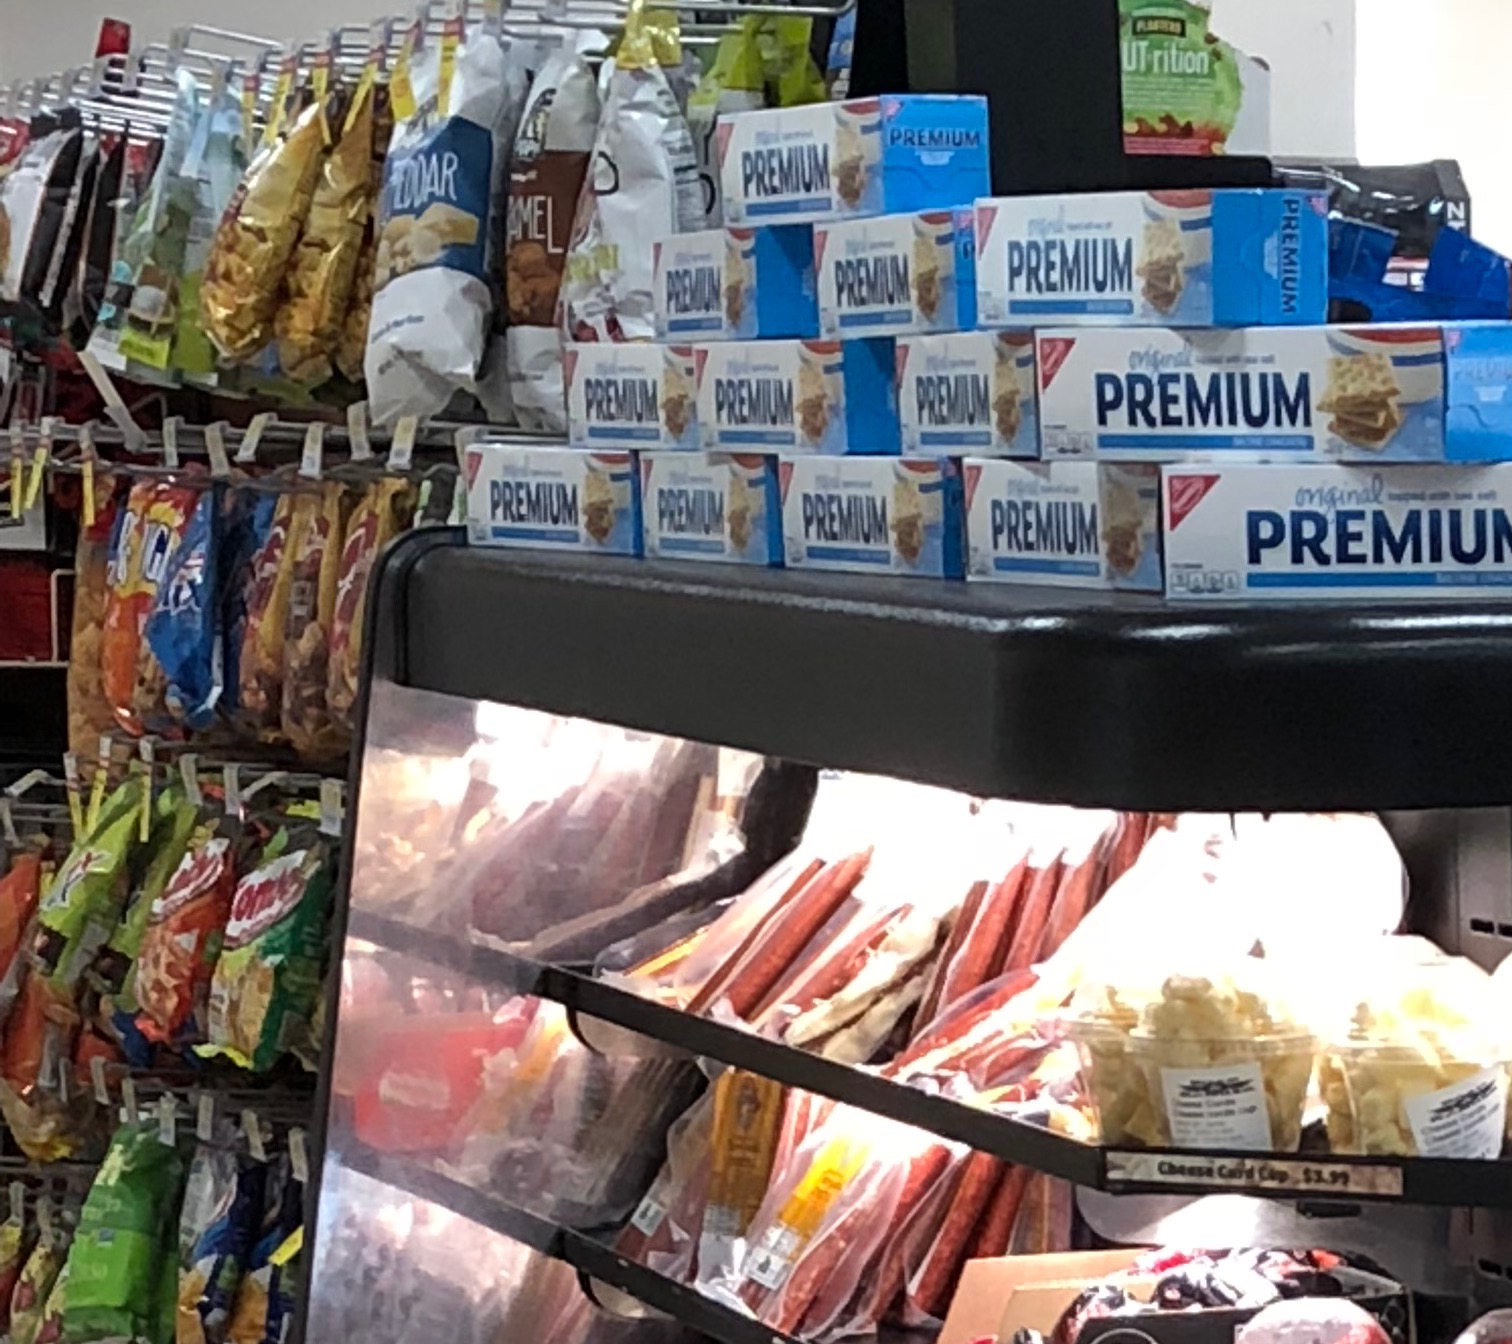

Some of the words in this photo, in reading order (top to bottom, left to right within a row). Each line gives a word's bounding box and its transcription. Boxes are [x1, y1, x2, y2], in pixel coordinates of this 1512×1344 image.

[890, 128, 980, 147] PREMIUM
[742, 144, 831, 198] PREMIUM
[1007, 238, 1133, 294] PREMIUM
[1282, 197, 1301, 314] PREMIUM
[666, 266, 722, 313] PREMIUM
[834, 254, 911, 307] PREMIUM
[584, 378, 660, 422] PREMIUM
[714, 378, 795, 426] PREMIUM
[916, 374, 990, 425] PREMIUM
[1095, 372, 1312, 428] PREMIUM
[490, 480, 579, 527] PREMIUM
[658, 488, 724, 535] PREMIUM
[803, 492, 887, 550] PREMIUM
[1295, 475, 1384, 522] original
[991, 498, 1098, 555] PREMIUM
[1157, 1160, 1213, 1178] Cheese
[1303, 1167, 1350, 1186] $3.99
